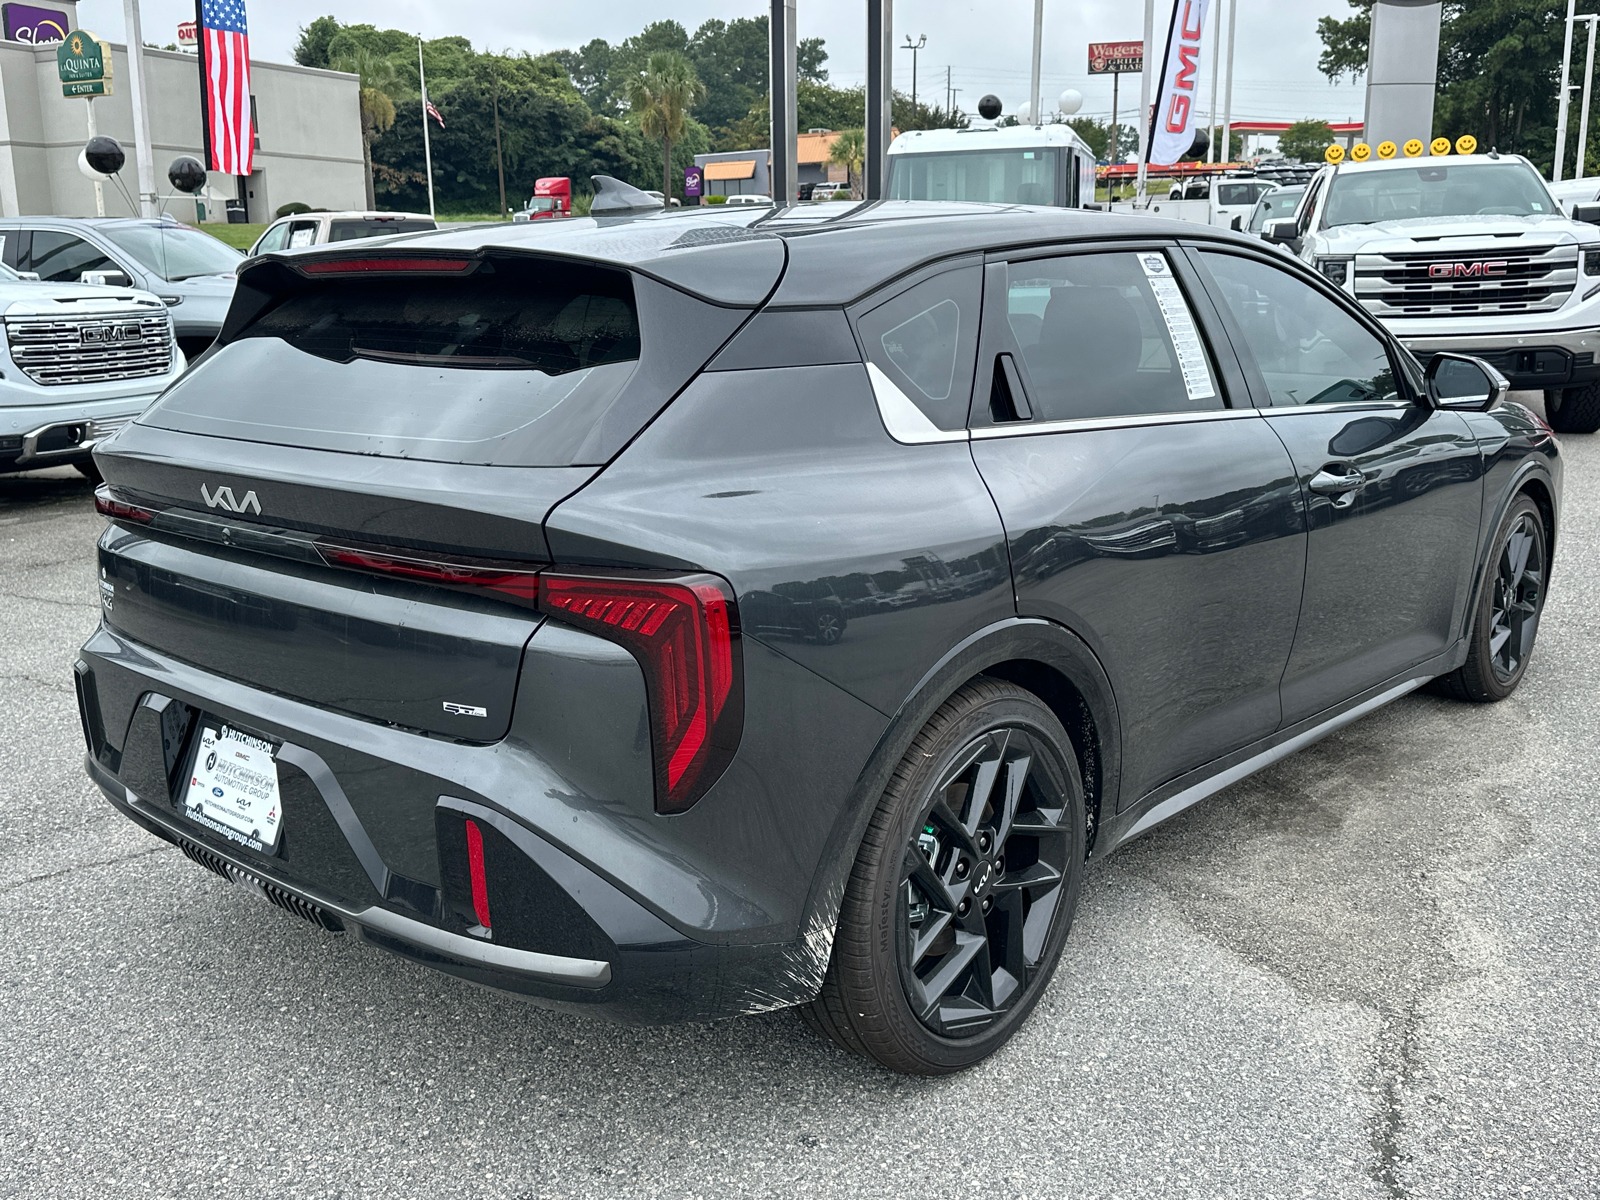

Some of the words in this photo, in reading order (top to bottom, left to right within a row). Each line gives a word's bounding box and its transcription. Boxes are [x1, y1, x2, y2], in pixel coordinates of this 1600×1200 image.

[1091, 44, 1143, 58] Wagers
[65, 58, 100, 73] QUINTA
[1166, 0, 1201, 133] GMC
[77, 84, 93, 92] ENTER
[1428, 261, 1507, 278] GMC
[82, 324, 141, 342] GMC
[229, 729, 273, 755] HUTCHINSON
[235, 751, 250, 761] GMC
[216, 758, 276, 792] HUTCHINSON
[214, 773, 250, 793] AUTOMOTIVE
[249, 786, 270, 800] GROUP
[185, 806, 263, 852] Hutchinsonautogroup.com
